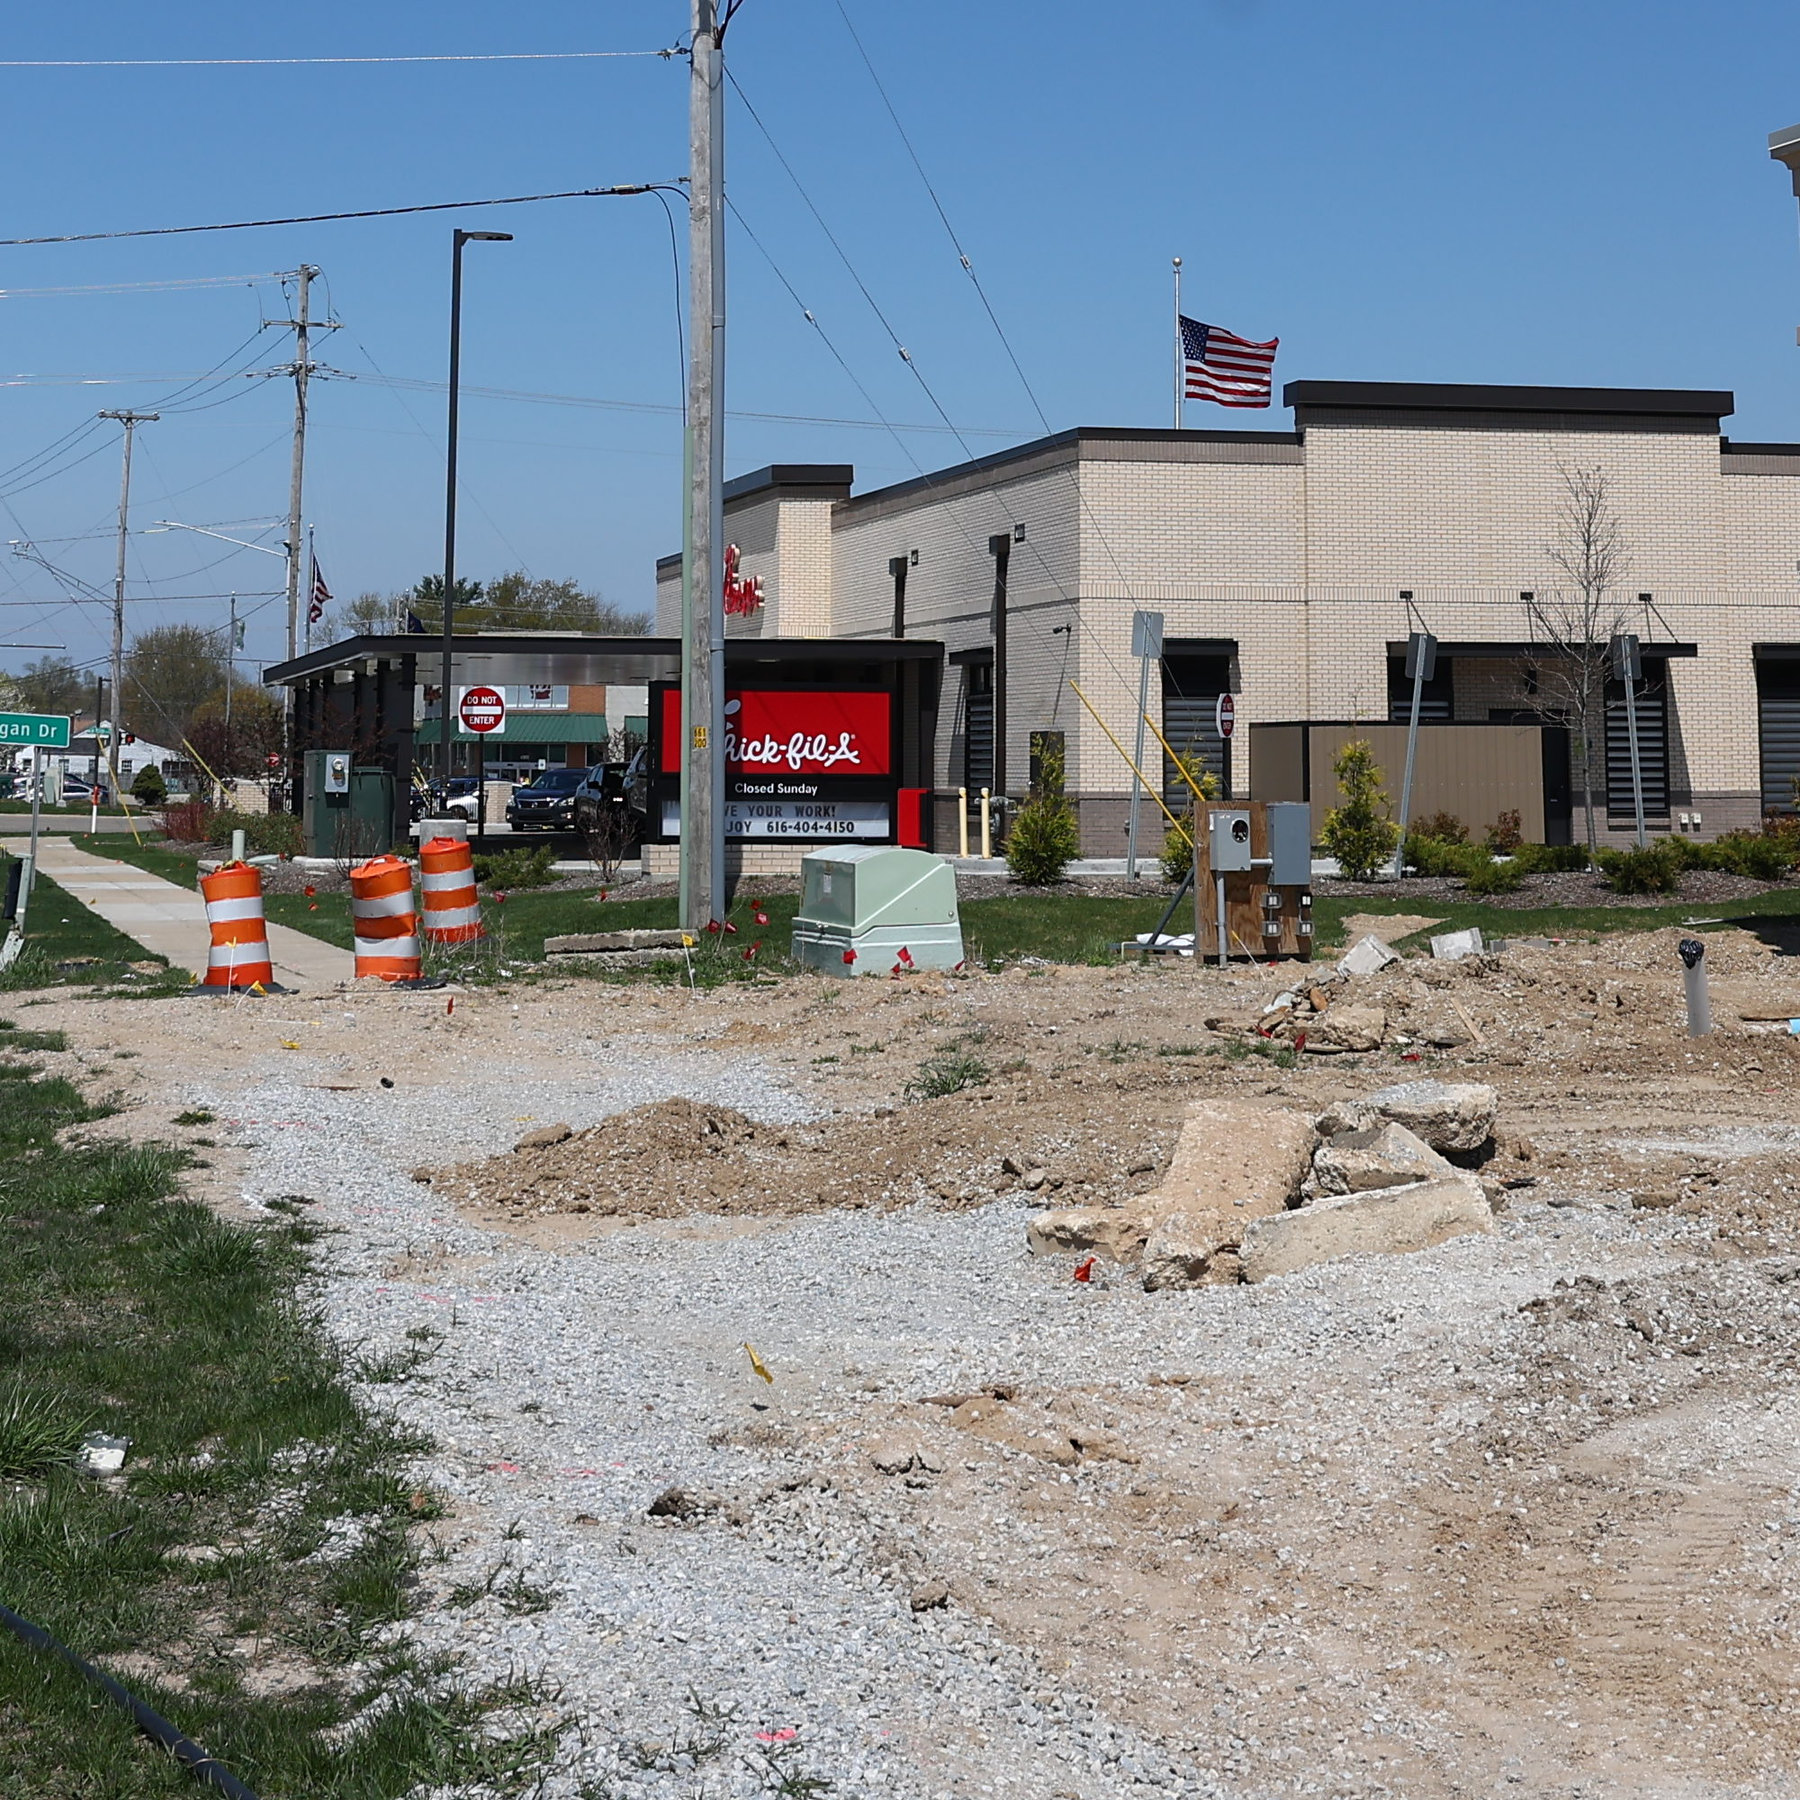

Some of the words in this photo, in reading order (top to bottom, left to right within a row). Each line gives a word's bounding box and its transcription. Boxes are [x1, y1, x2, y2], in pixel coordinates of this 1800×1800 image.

[467, 696, 478, 704] DO
[481, 696, 497, 704] NOT
[469, 716, 495, 725] ENTER
[38, 724, 58, 738] Dr
[725, 722, 861, 770] hick-fil-A
[735, 783, 774, 794] Closed
[777, 783, 818, 796] Sunday
[749, 805, 782, 818] YOUR
[795, 806, 836, 817] WORK!
[726, 821, 752, 833] JOY
[767, 821, 854, 833] 616-404-4150
